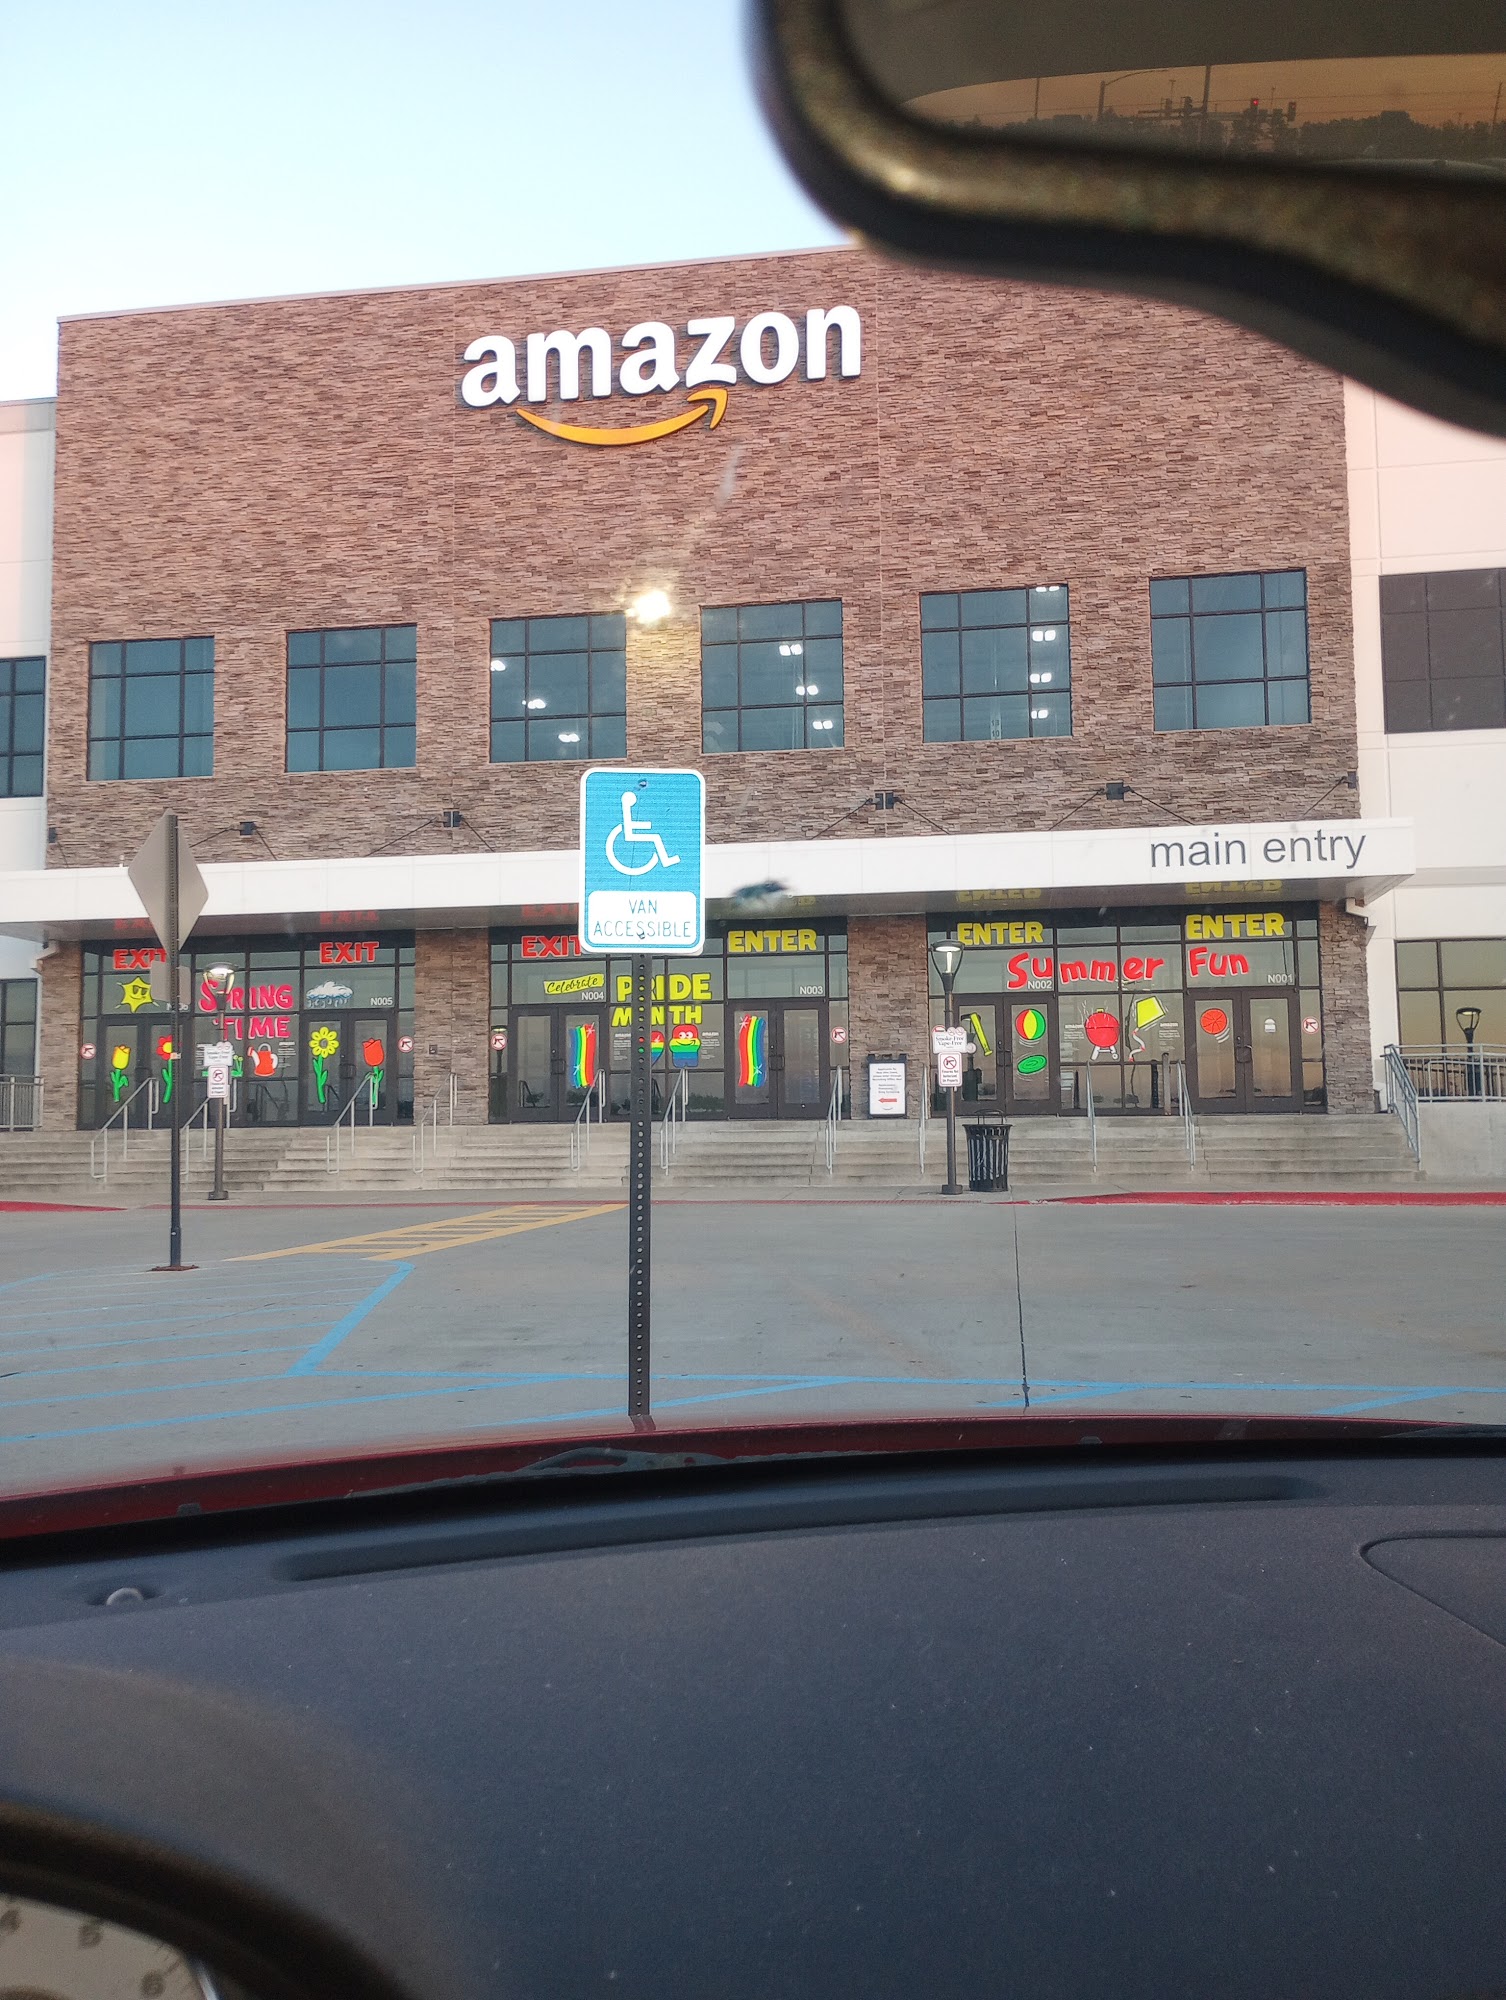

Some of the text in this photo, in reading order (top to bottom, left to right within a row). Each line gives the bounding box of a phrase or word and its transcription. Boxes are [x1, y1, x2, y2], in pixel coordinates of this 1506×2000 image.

[461, 305, 861, 407] amazon
[1150, 829, 1367, 869] main entry
[628, 899, 658, 915] VAN
[593, 921, 692, 939] ACCESSIBLE
[957, 921, 1044, 946] ENTER
[1186, 913, 1285, 939] ENTER
[319, 941, 380, 964] EXIT
[521, 935, 581, 958] EXIT
[728, 929, 818, 953] ENTER
[1007, 947, 1250, 990] Summer Fun
[1267, 974, 1293, 984] N001
[199, 980, 293, 1012] SRING
[581, 991, 604, 1001] N004
[800, 986, 823, 996] N003
[1027, 980, 1053, 990] N002
[370, 997, 393, 1006] N005
[611, 1005, 702, 1027] MNTH
